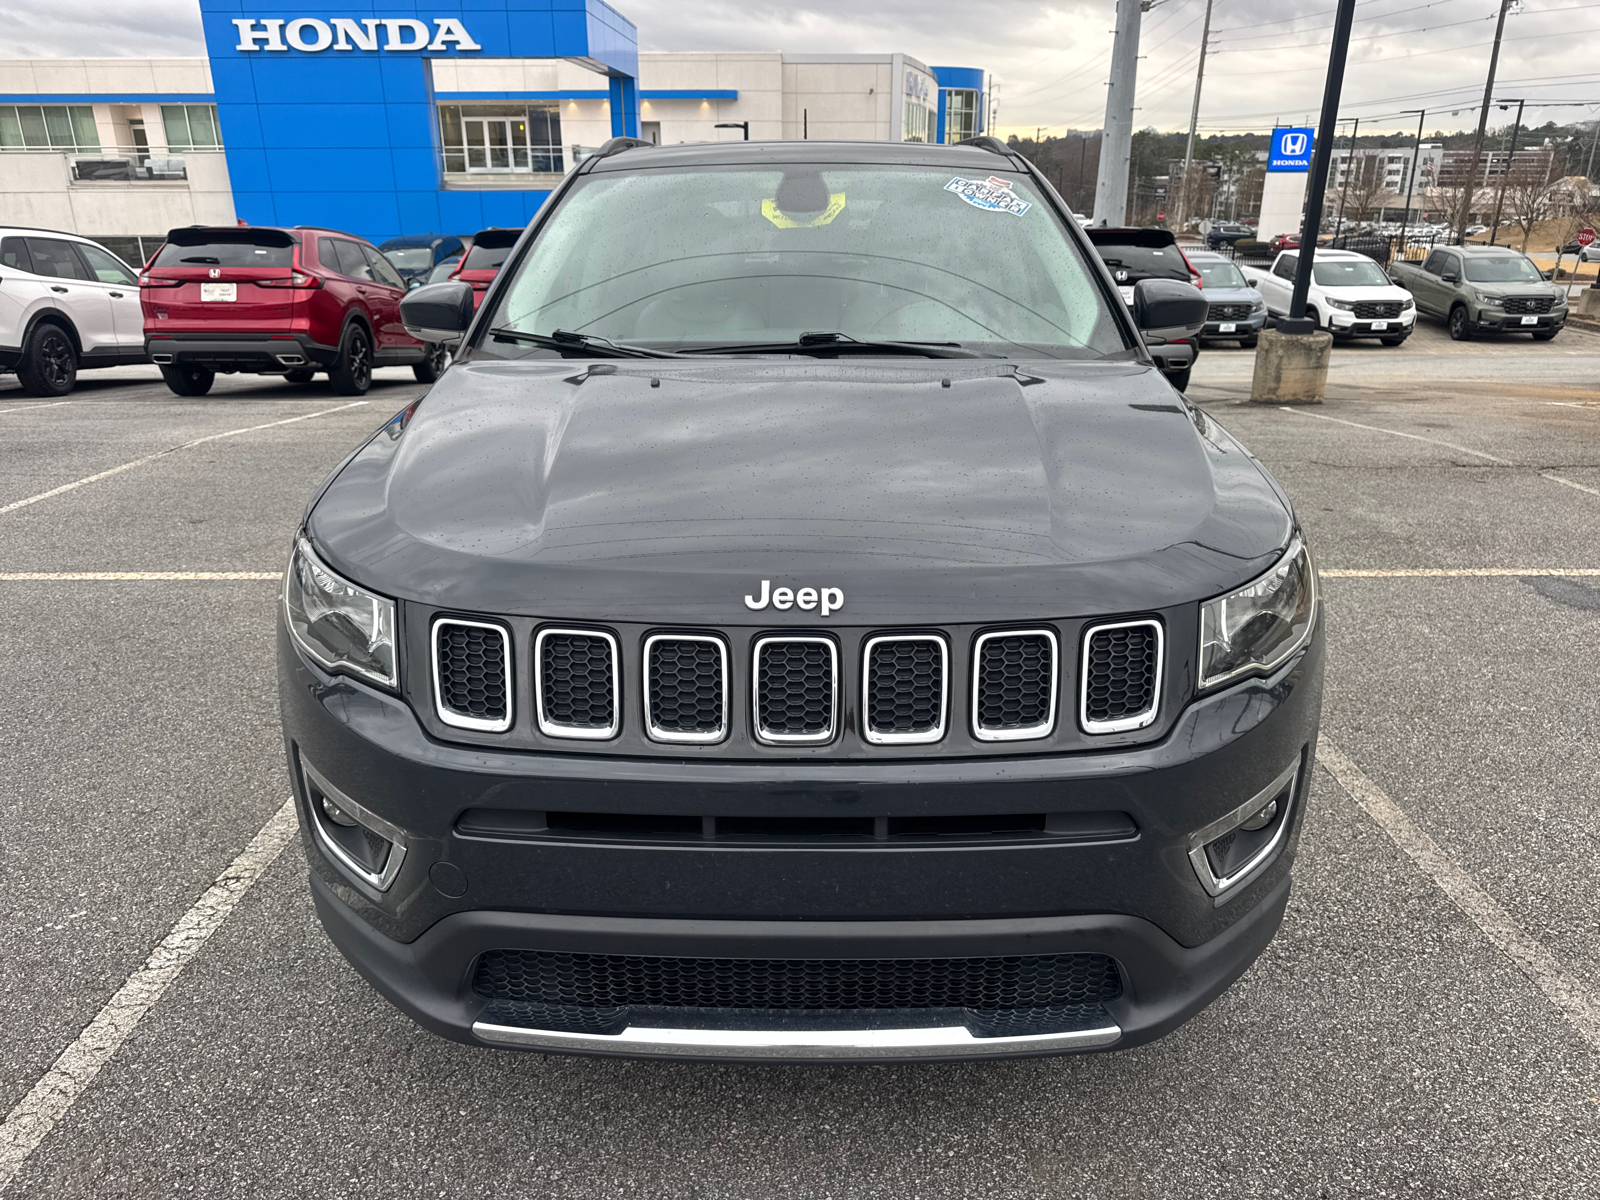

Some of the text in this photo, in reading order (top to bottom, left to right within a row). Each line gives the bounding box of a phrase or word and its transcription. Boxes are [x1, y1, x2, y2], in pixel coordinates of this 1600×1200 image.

[232, 18, 482, 51] HONDA
[961, 187, 1022, 213] OWNER
[1578, 233, 1593, 241] STOP
[744, 580, 844, 616] Jeep
